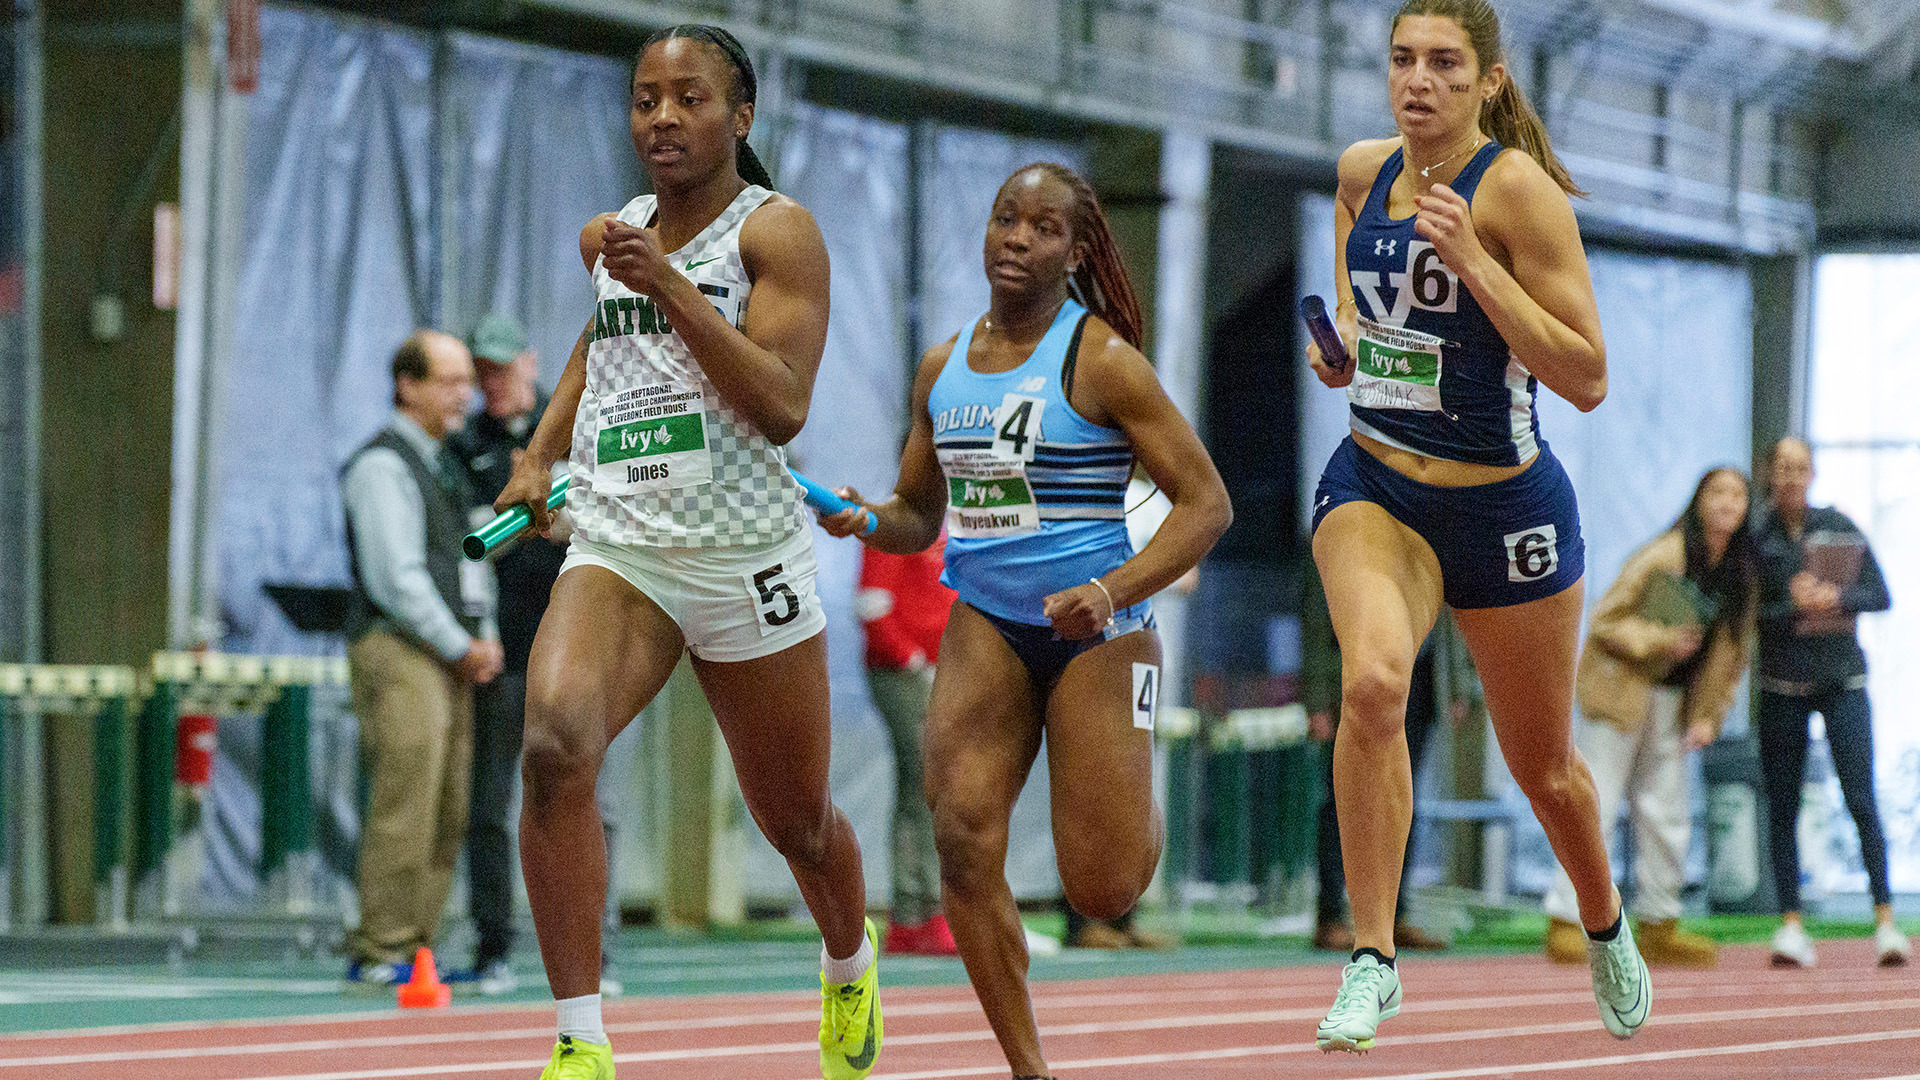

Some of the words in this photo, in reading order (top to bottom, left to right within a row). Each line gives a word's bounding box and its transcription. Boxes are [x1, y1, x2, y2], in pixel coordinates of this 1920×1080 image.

[1412, 247, 1450, 307] 6
[1370, 347, 1395, 376] Ivy
[615, 402, 631, 413] TRACK
[635, 398, 649, 408] FIELD
[649, 391, 701, 406] CHAMPIONSHIPS
[631, 384, 673, 400] HEPTAGONAL
[614, 409, 643, 423] LEVERONE
[643, 406, 662, 418] FIELD
[662, 402, 688, 415] HOUSE
[620, 428, 653, 453] Ivy
[999, 400, 1034, 455] 4
[627, 462, 669, 484] Jones
[1514, 533, 1552, 578] 6
[752, 563, 800, 626] 5
[1137, 669, 1153, 725] 4
